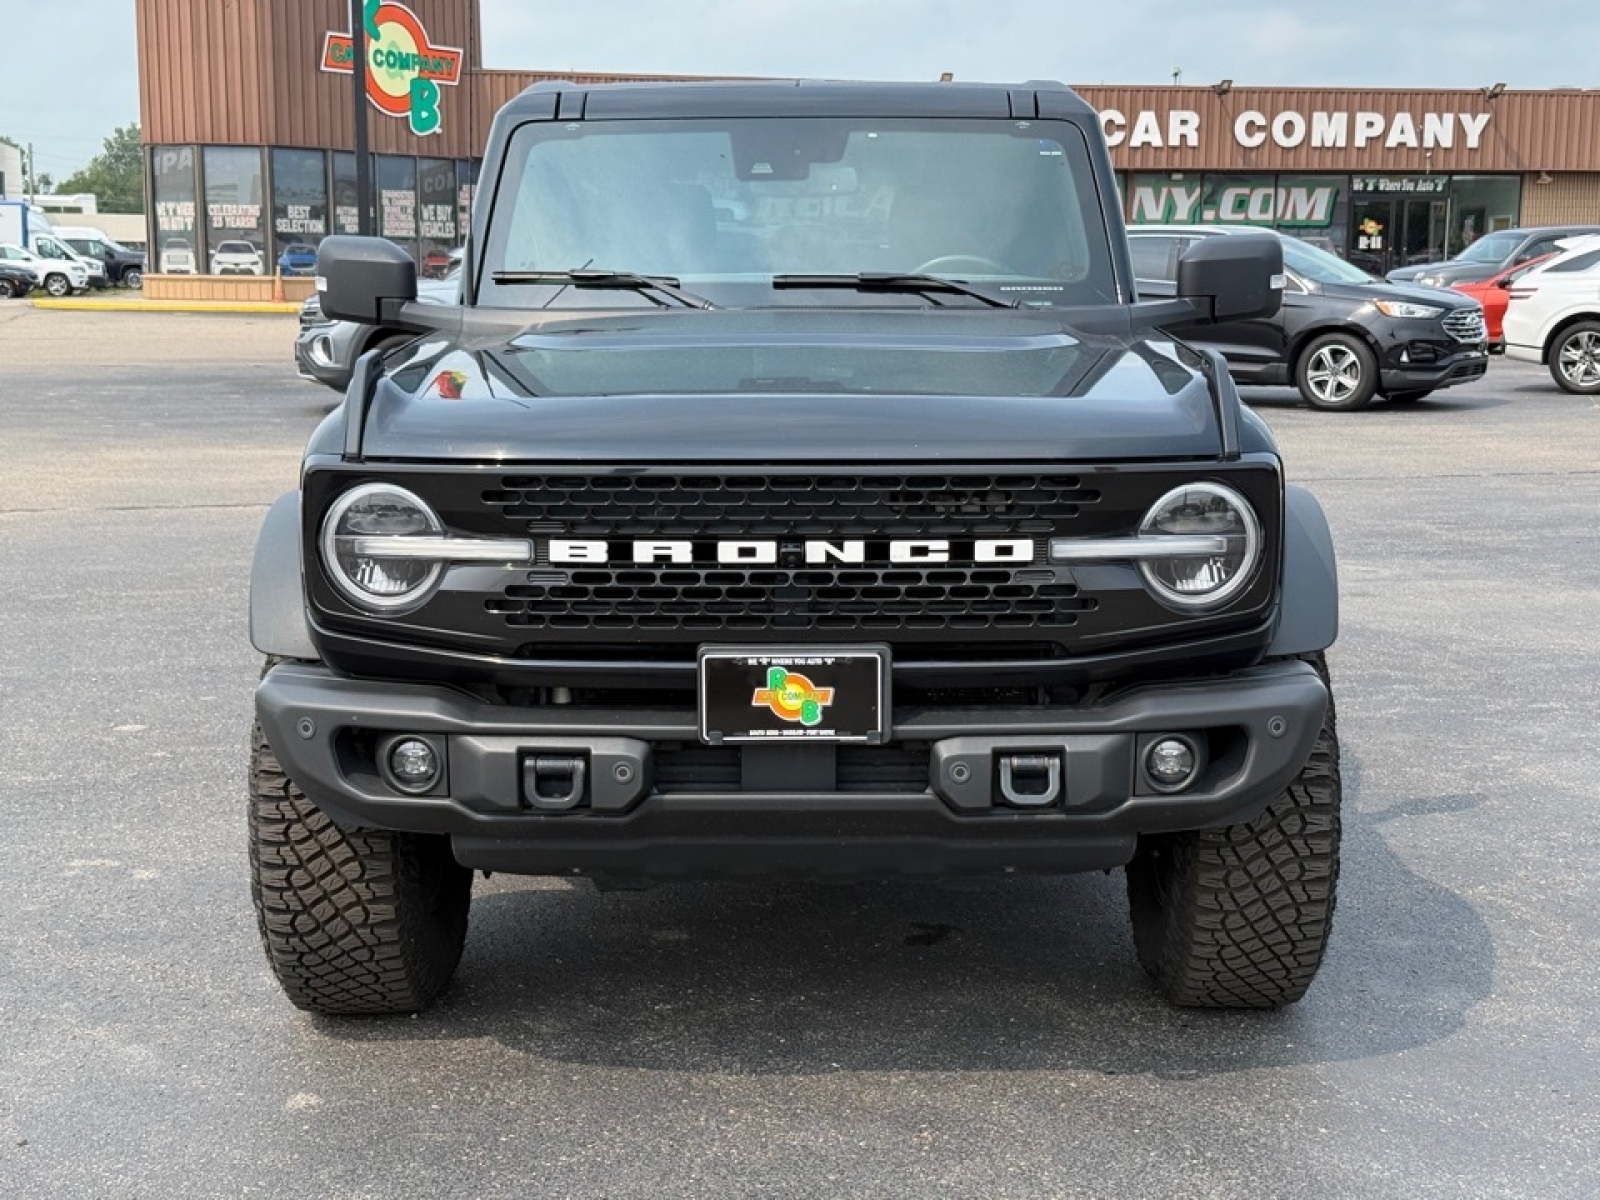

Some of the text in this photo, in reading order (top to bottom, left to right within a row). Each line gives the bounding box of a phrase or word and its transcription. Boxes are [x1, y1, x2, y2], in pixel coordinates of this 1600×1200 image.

[329, 42, 455, 76] CA COMPANY
[410, 77, 440, 133] B
[1099, 110, 1491, 149] CAR COMPANY
[287, 204, 311, 220] BEST
[421, 204, 453, 221] WE BUY
[1132, 186, 1332, 222] NY.COM
[275, 217, 325, 234] SELECTION
[420, 221, 456, 239] VEHICLES
[548, 539, 1034, 563] BRONCO
[768, 668, 788, 692] R
[801, 700, 821, 724] B
